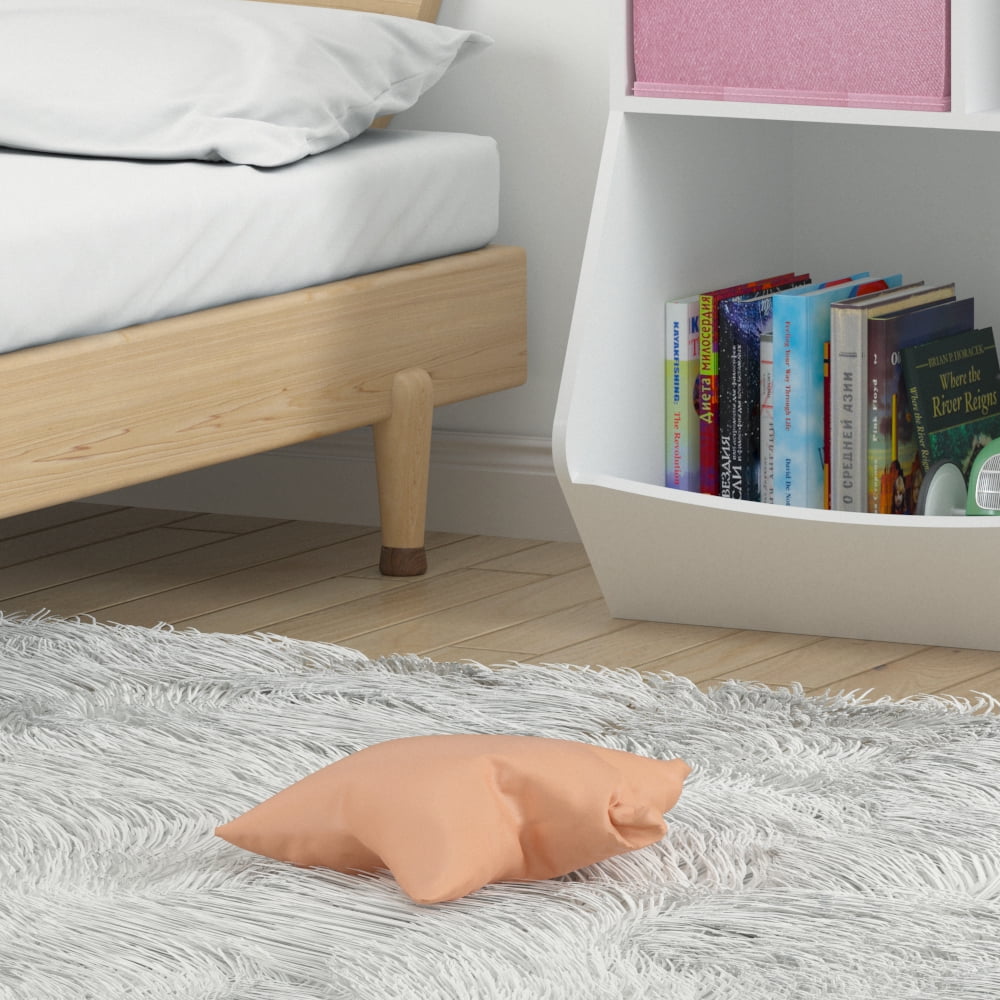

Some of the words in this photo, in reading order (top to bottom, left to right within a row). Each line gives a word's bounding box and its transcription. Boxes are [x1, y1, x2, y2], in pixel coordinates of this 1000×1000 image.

[701, 296, 713, 371] милосердия
[842, 372, 853, 413] АЗИИ
[939, 371, 967, 391] Where
[968, 365, 981, 383] the
[699, 377, 714, 424] Диета
[909, 386, 920, 412] Where
[932, 394, 963, 419] River
[964, 388, 998, 416] Reigns
[673, 412, 682, 428] The
[914, 412, 923, 425] the
[917, 425, 927, 449] River
[673, 432, 682, 485] Revolution
[721, 436, 731, 498] ВЕЗДИЯ
[840, 419, 853, 489] СРЕДНЕЙ
[920, 449, 930, 472] Reign
[732, 466, 742, 500] СЛИ
[785, 481, 792, 491] De
